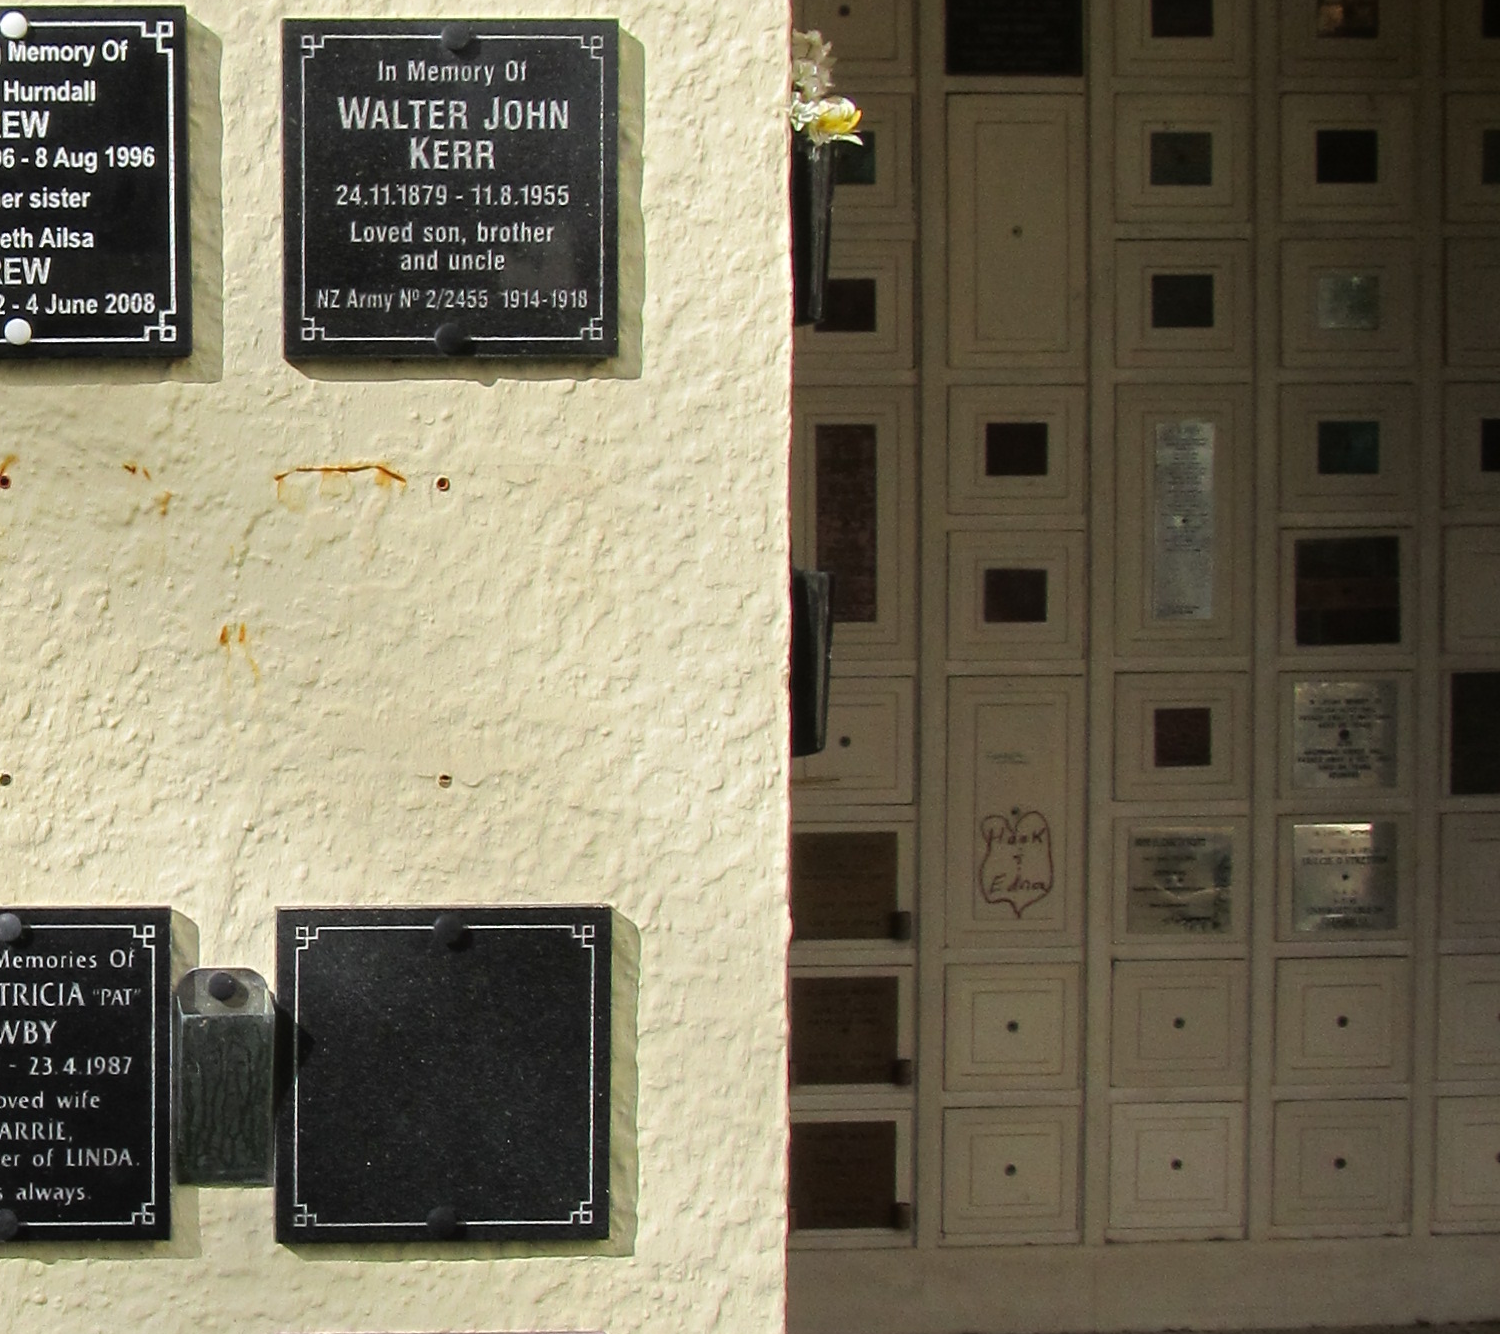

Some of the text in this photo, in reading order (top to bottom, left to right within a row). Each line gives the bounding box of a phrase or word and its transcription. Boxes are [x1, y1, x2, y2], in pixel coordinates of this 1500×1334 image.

[378, 60, 526, 86] In Memory Of
[4, 80, 96, 102] Hurndall
[337, 96, 568, 130] WALTER JOHN
[35, 147, 48, 168] 8
[53, 147, 98, 173] Aug
[105, 146, 155, 167] 1996
[410, 136, 495, 169] KERR
[29, 186, 91, 208] sister
[336, 184, 447, 206] 24.11.1879
[471, 184, 569, 206] 11.8.1955
[39, 227, 94, 248] Ailsa
[317, 289, 340, 308] NZ
[346, 288, 393, 312] Army
[426, 288, 488, 310] 2/2455
[500, 289, 588, 310] 1914-1918
[110, 947, 135, 968] Of
[29, 1056, 132, 1075] 23.4.1987
